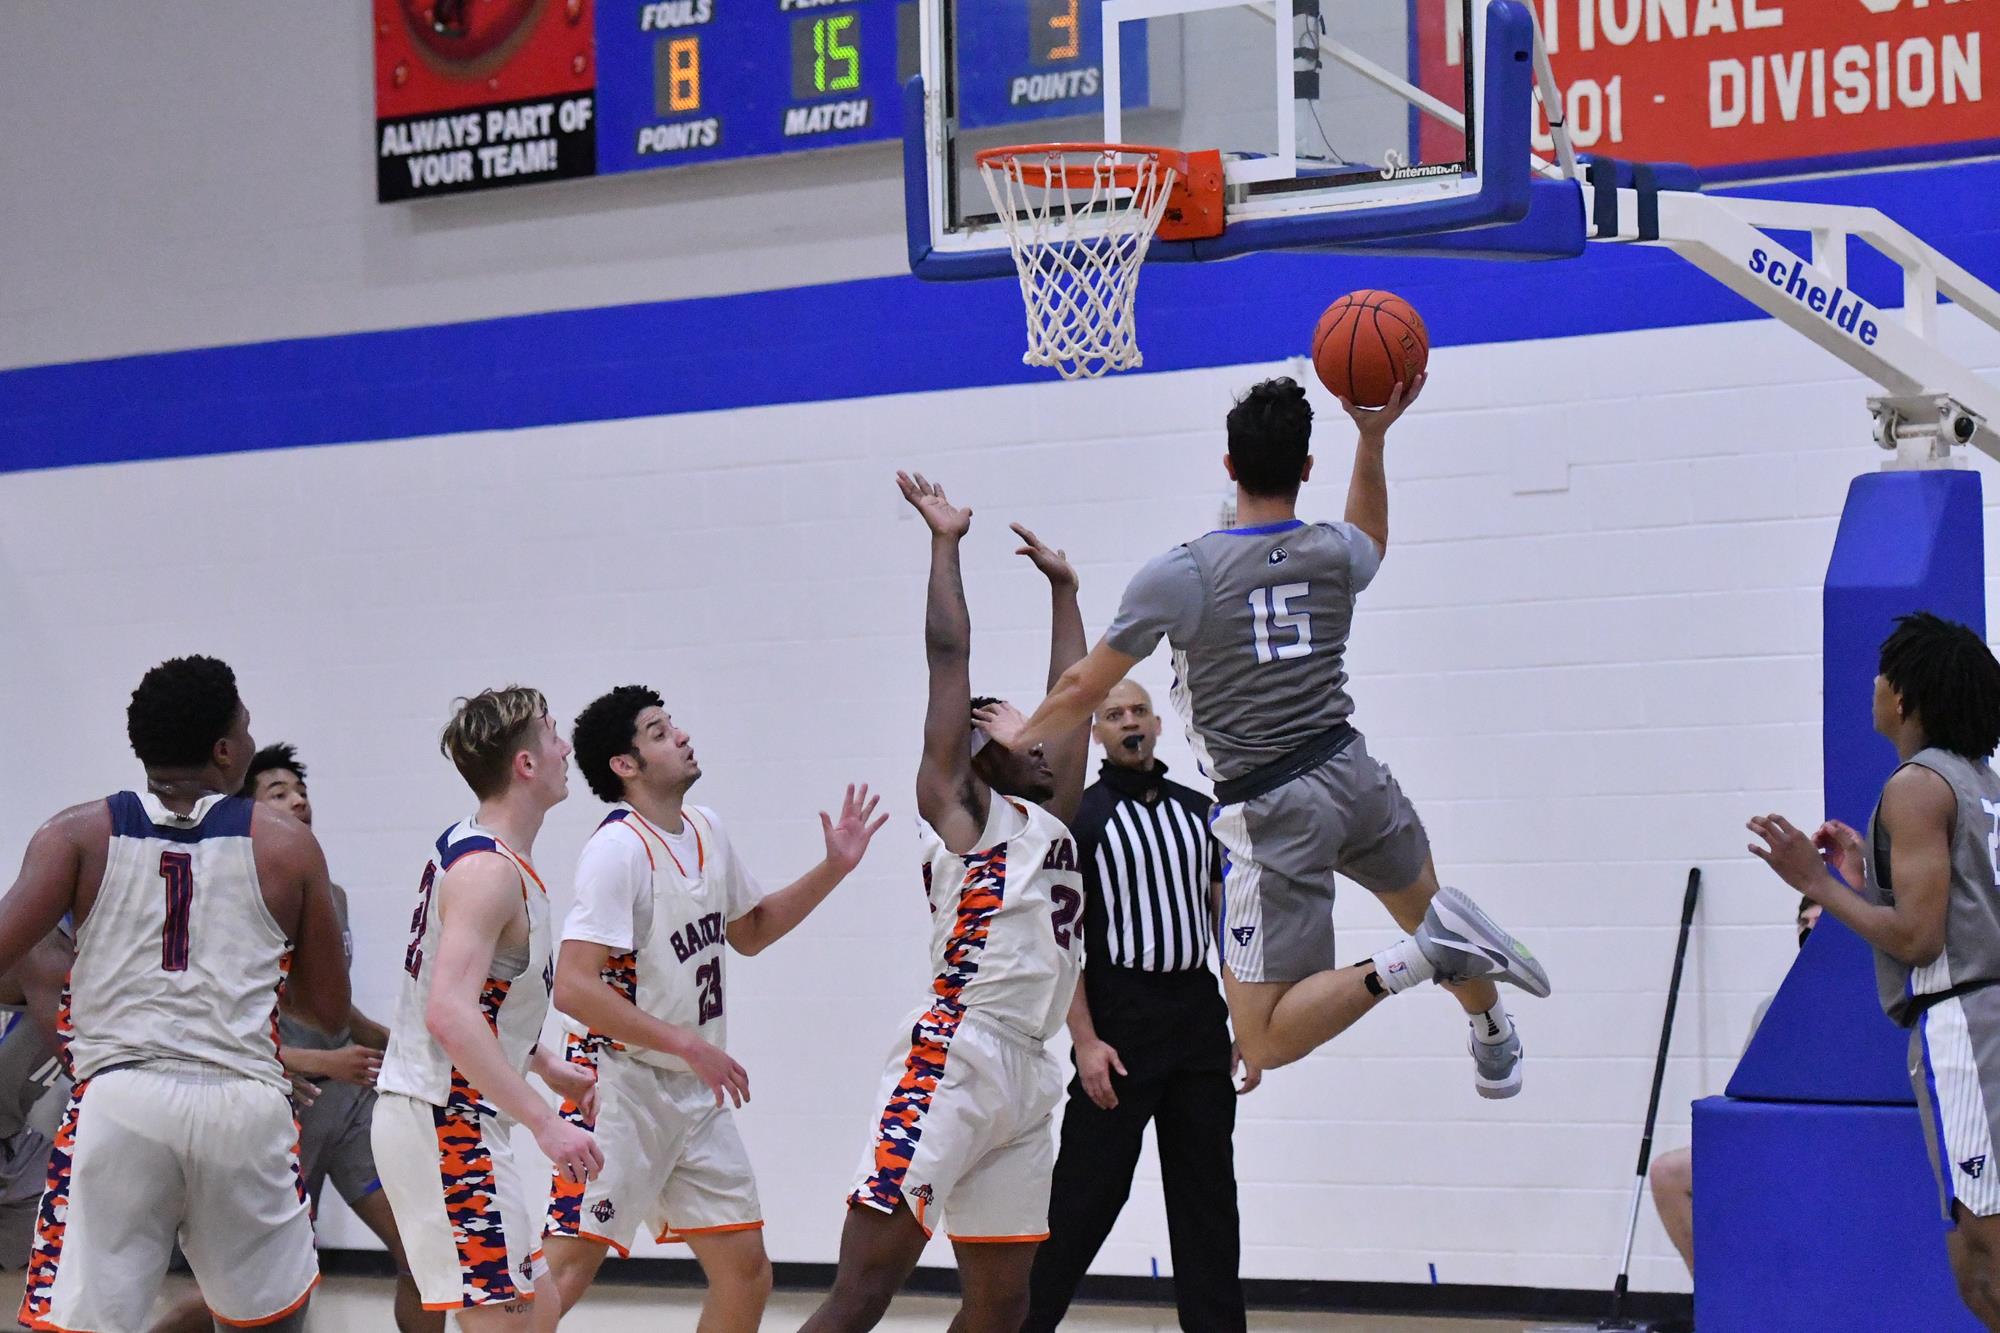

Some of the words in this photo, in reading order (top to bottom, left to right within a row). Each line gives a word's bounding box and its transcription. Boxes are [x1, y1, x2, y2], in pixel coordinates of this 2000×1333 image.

[641, 0, 712, 31] FOULS
[668, 38, 700, 112] 8
[813, 16, 859, 92] 15
[1010, 67, 1099, 105] POINTS
[1708, 31, 1982, 129] DIVISION
[381, 112, 482, 157] ALWAYS
[486, 103, 554, 143] PART
[558, 98, 593, 133] OF
[637, 118, 719, 154] POINTS
[784, 100, 869, 136] MATCH
[407, 150, 474, 188] YOUR
[477, 139, 558, 179] TEAM!
[1749, 248, 1878, 346] schelde
[1247, 581, 1313, 665] 15
[159, 850, 193, 972] 1
